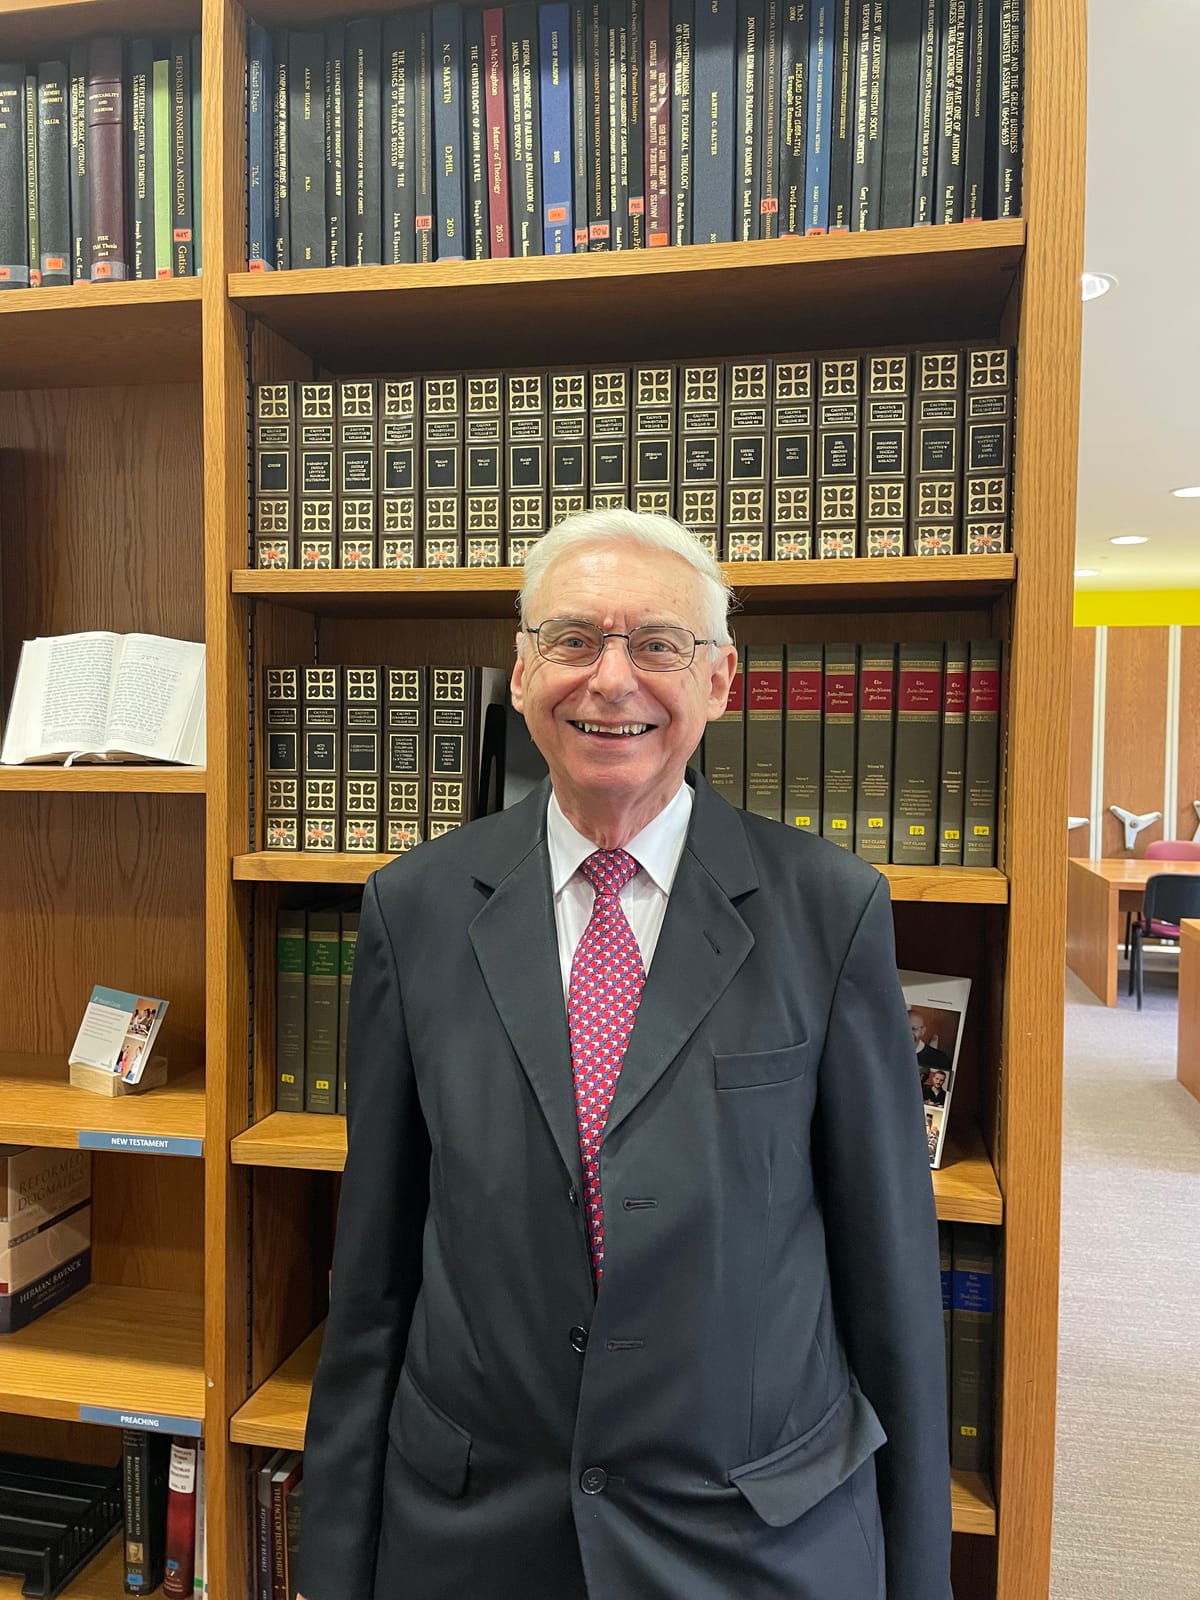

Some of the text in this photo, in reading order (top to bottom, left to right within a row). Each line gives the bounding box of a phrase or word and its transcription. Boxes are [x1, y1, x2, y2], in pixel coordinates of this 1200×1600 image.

[873, 2, 882, 24] JAMES
[873, 25, 881, 34] W.
[746, 17, 755, 53] JONATHAN
[1002, 12, 1011, 64] WESTMINSTER
[442, 44, 452, 103] N. C. MARTIN
[490, 35, 499, 96] Ian McNaughton
[856, 4, 870, 164] REFORM IN ITS ANTEBELLUM AMERICAN CONTEXT
[945, 25, 956, 137] TRUE DOCTRINE OF JUSTIFICATION
[952, 1, 965, 166] CRITICAL EVALUATION OF PART ONE OF ANTHONY
[391, 90, 398, 100] OF
[793, 63, 803, 118] RICHARD DAVIS
[870, 81, 880, 115] CHRISTIAN
[1001, 66, 1010, 104] ASSEMBLY
[1010, 25, 1019, 154] BURGES AND THE GREAT BUSINESS
[279, 110, 286, 119] OF
[398, 107, 405, 118] OF
[471, 45, 481, 182] THE CHRISTOLOGY OF JOHN FLAVEL
[745, 95, 754, 134] PREACHING
[870, 117, 879, 141] SOCIAL
[27, 137, 35, 158] THAT
[138, 75, 146, 199] SEVENTEENTH-CENTURY WESTMINSTER
[176, 56, 185, 215] REFORMED EVANGELICAL ANGLICAN
[681, 98, 689, 190] THE POLEMICAL THEOLOGY
[745, 135, 753, 145] OF
[398, 160, 405, 170] IN
[493, 127, 503, 194] Master of Theology
[744, 146, 753, 176] ROMANS
[1003, 168, 1013, 216] Andrew Young
[416, 218, 431, 228] LUE
[496, 225, 504, 242] 2005
[178, 246, 187, 274] Gatiss
[111, 1137, 169, 1148] NEW TESTAMENT
[17, 1168, 84, 1211] DOGMATICS
[19, 1152, 83, 1195] REFORMED
[19, 1279, 50, 1304] HERMAN
[120, 1415, 160, 1427] PREACHING
